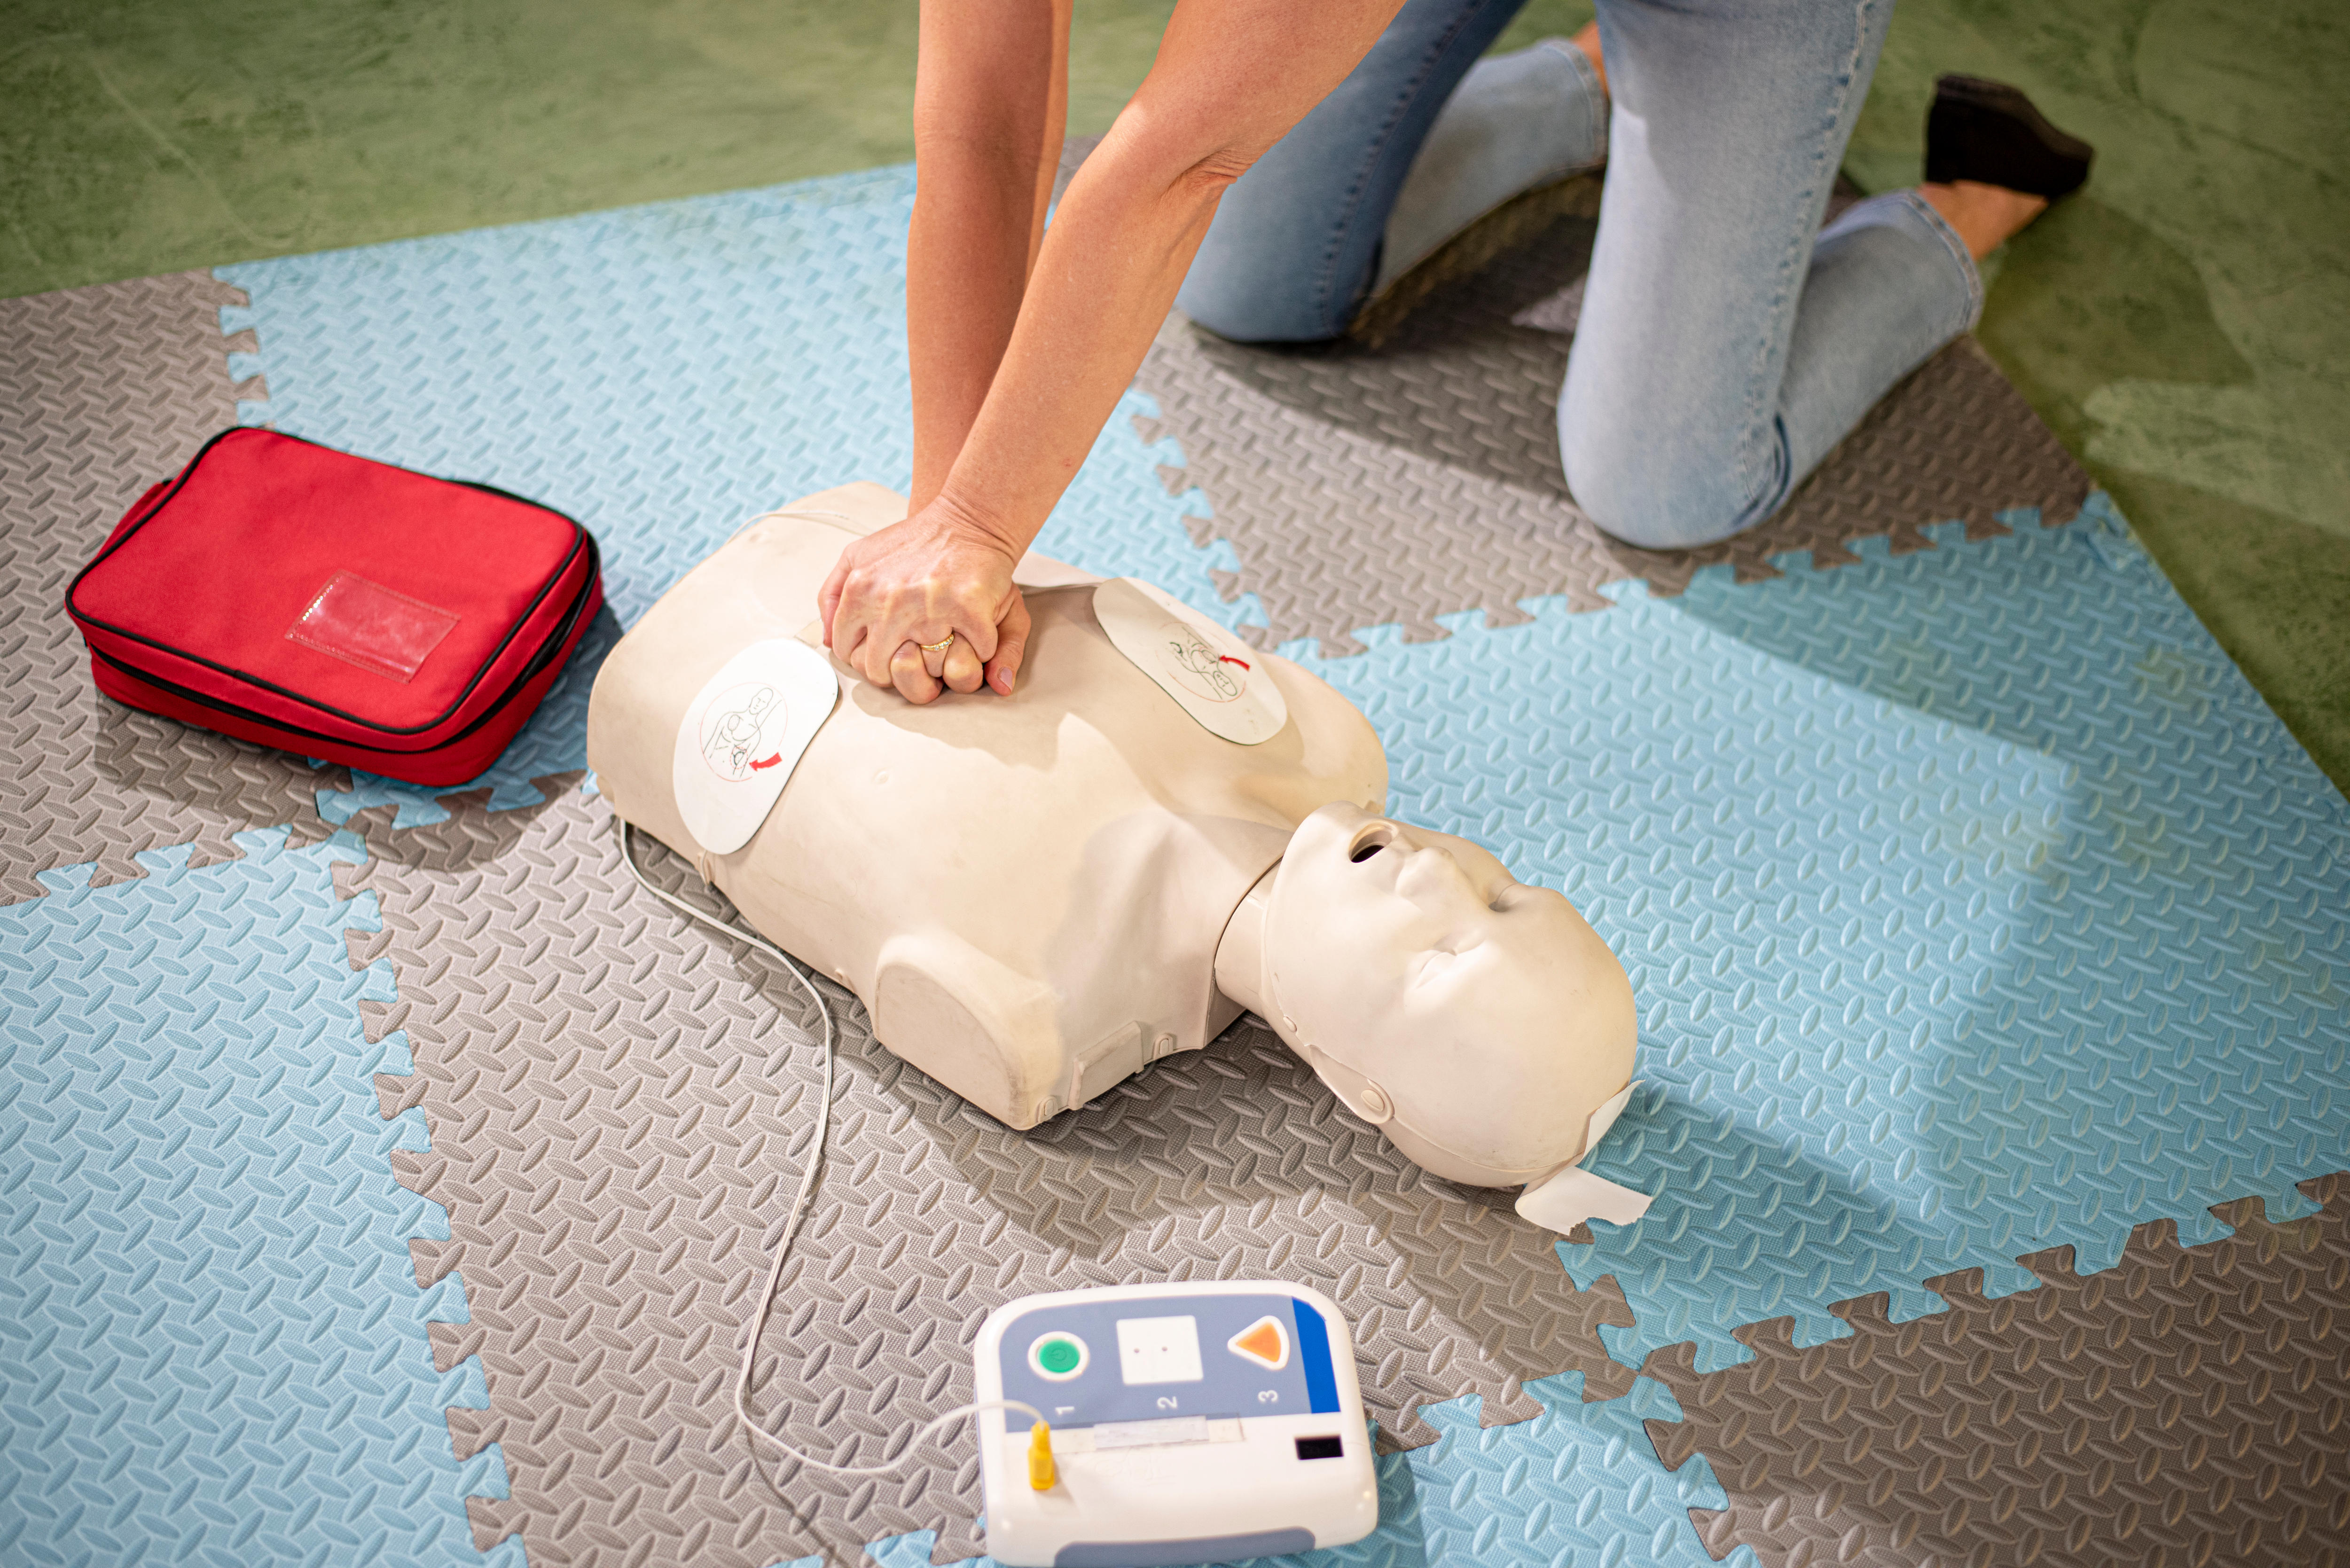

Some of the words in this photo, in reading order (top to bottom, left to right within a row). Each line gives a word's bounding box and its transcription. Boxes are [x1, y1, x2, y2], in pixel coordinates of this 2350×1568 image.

[1157, 1396, 1177, 1409] 2
[1258, 1389, 1278, 1403] 3
[1054, 1406, 1074, 1415] 1
